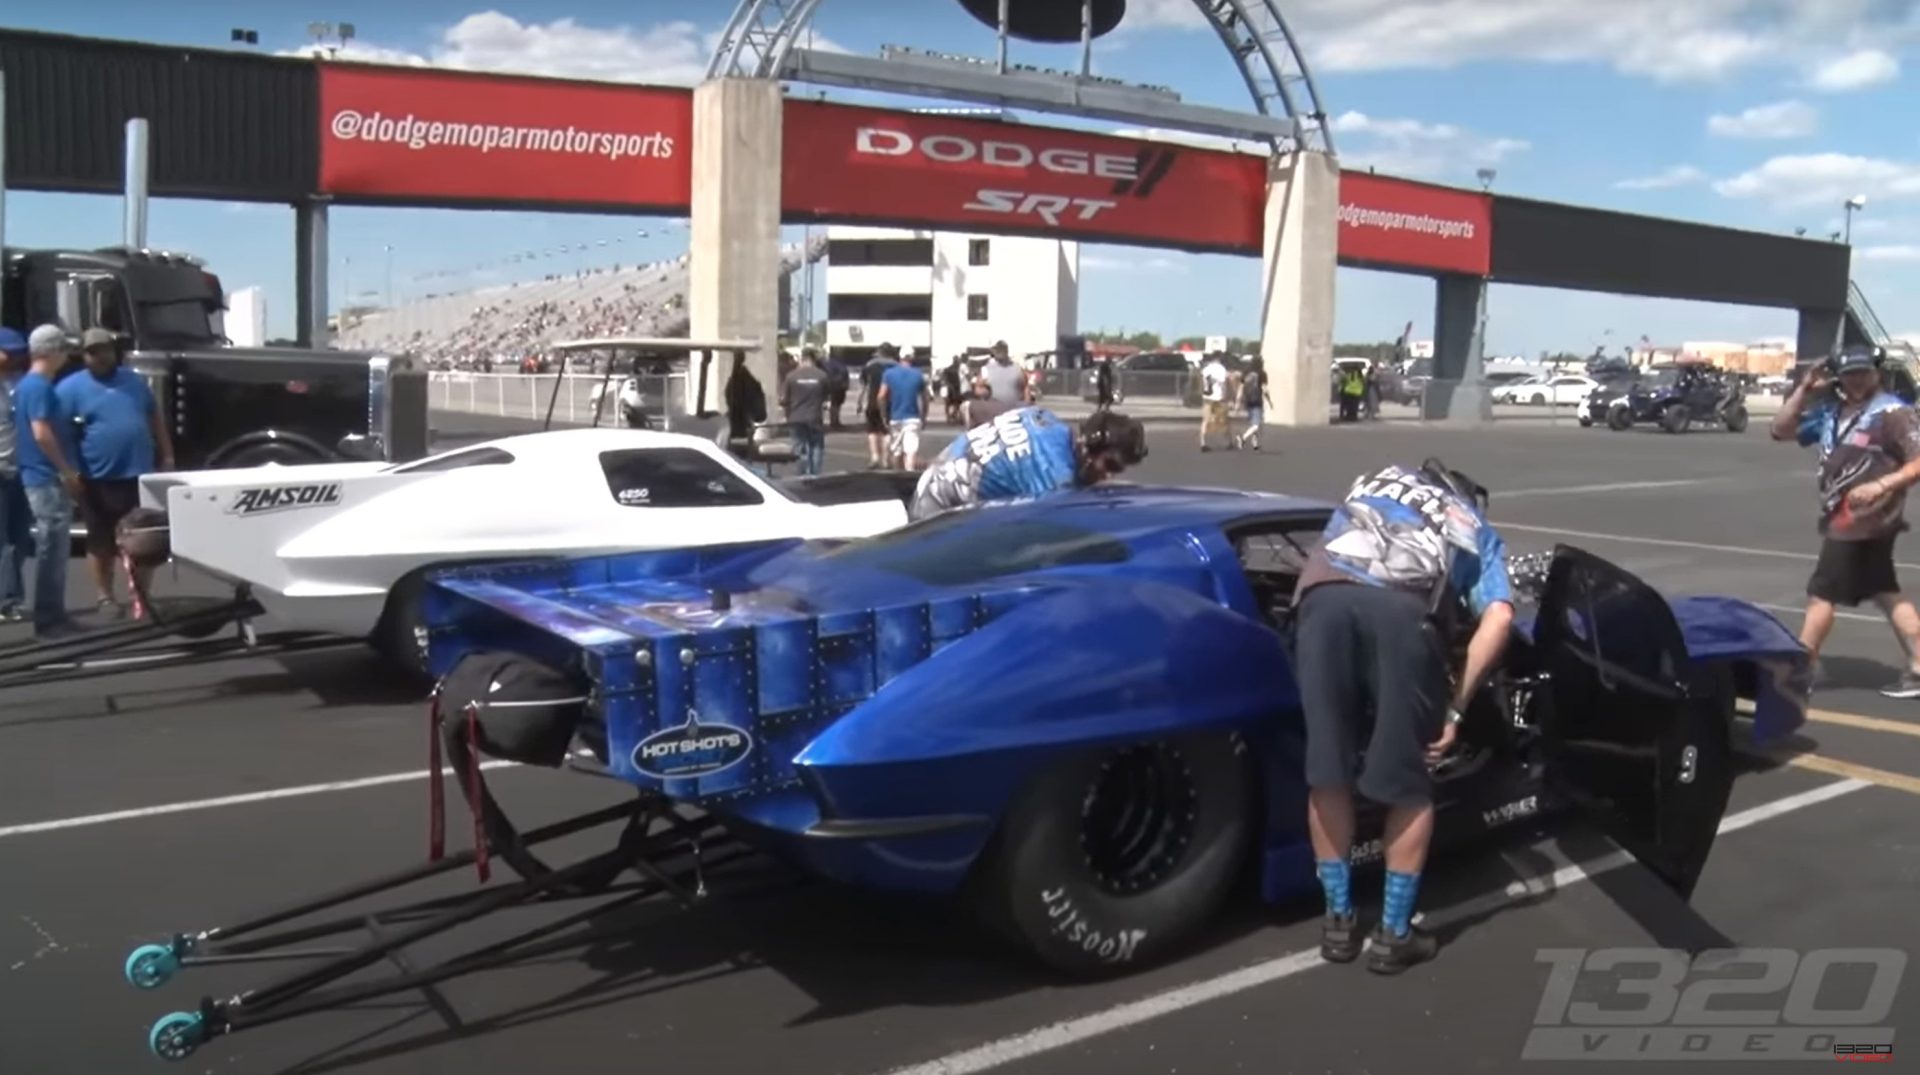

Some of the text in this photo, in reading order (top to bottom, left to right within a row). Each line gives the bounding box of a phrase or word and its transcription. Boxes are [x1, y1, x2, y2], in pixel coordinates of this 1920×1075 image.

[331, 110, 674, 160] @dodgemoparmotorsports
[856, 127, 1138, 180] DODGE
[963, 189, 1117, 225] SRT
[1336, 203, 1475, 239] odgemoparmotorsports
[233, 484, 339, 513] AMSOIL
[642, 741, 679, 759] HOT
